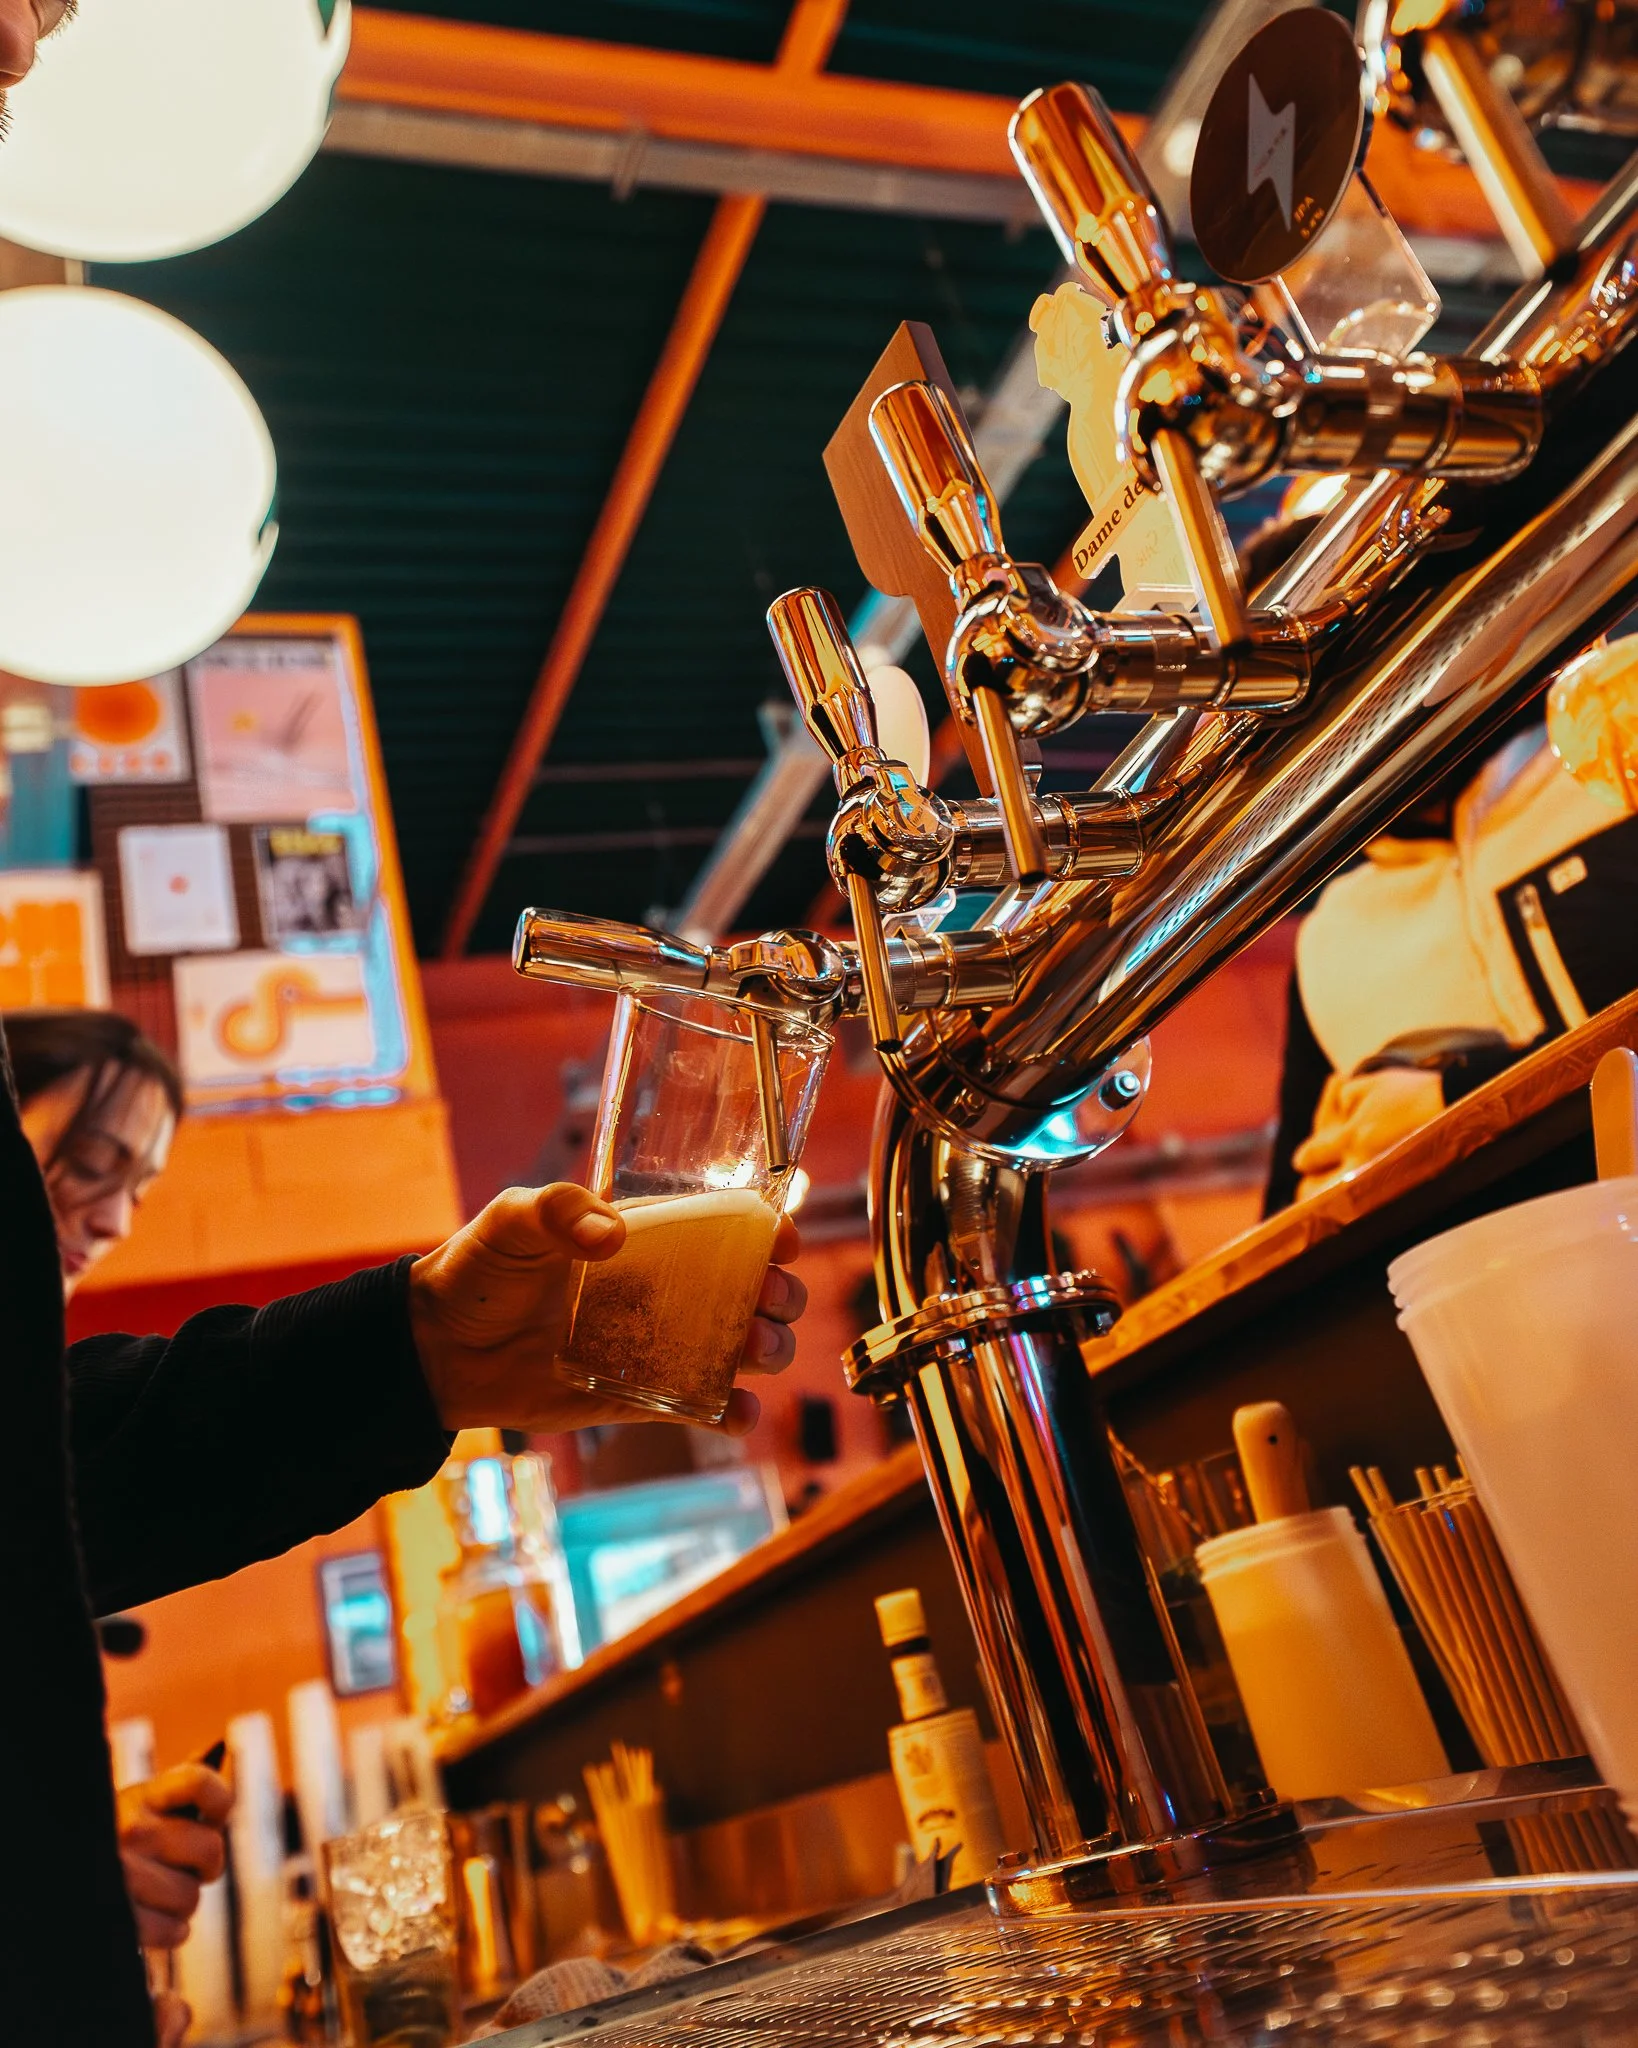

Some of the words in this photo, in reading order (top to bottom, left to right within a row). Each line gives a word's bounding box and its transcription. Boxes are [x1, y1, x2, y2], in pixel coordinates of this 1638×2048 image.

[1294, 196, 1315, 223] IPA
[1074, 509, 1122, 573] Dame
[1124, 480, 1145, 509] de
